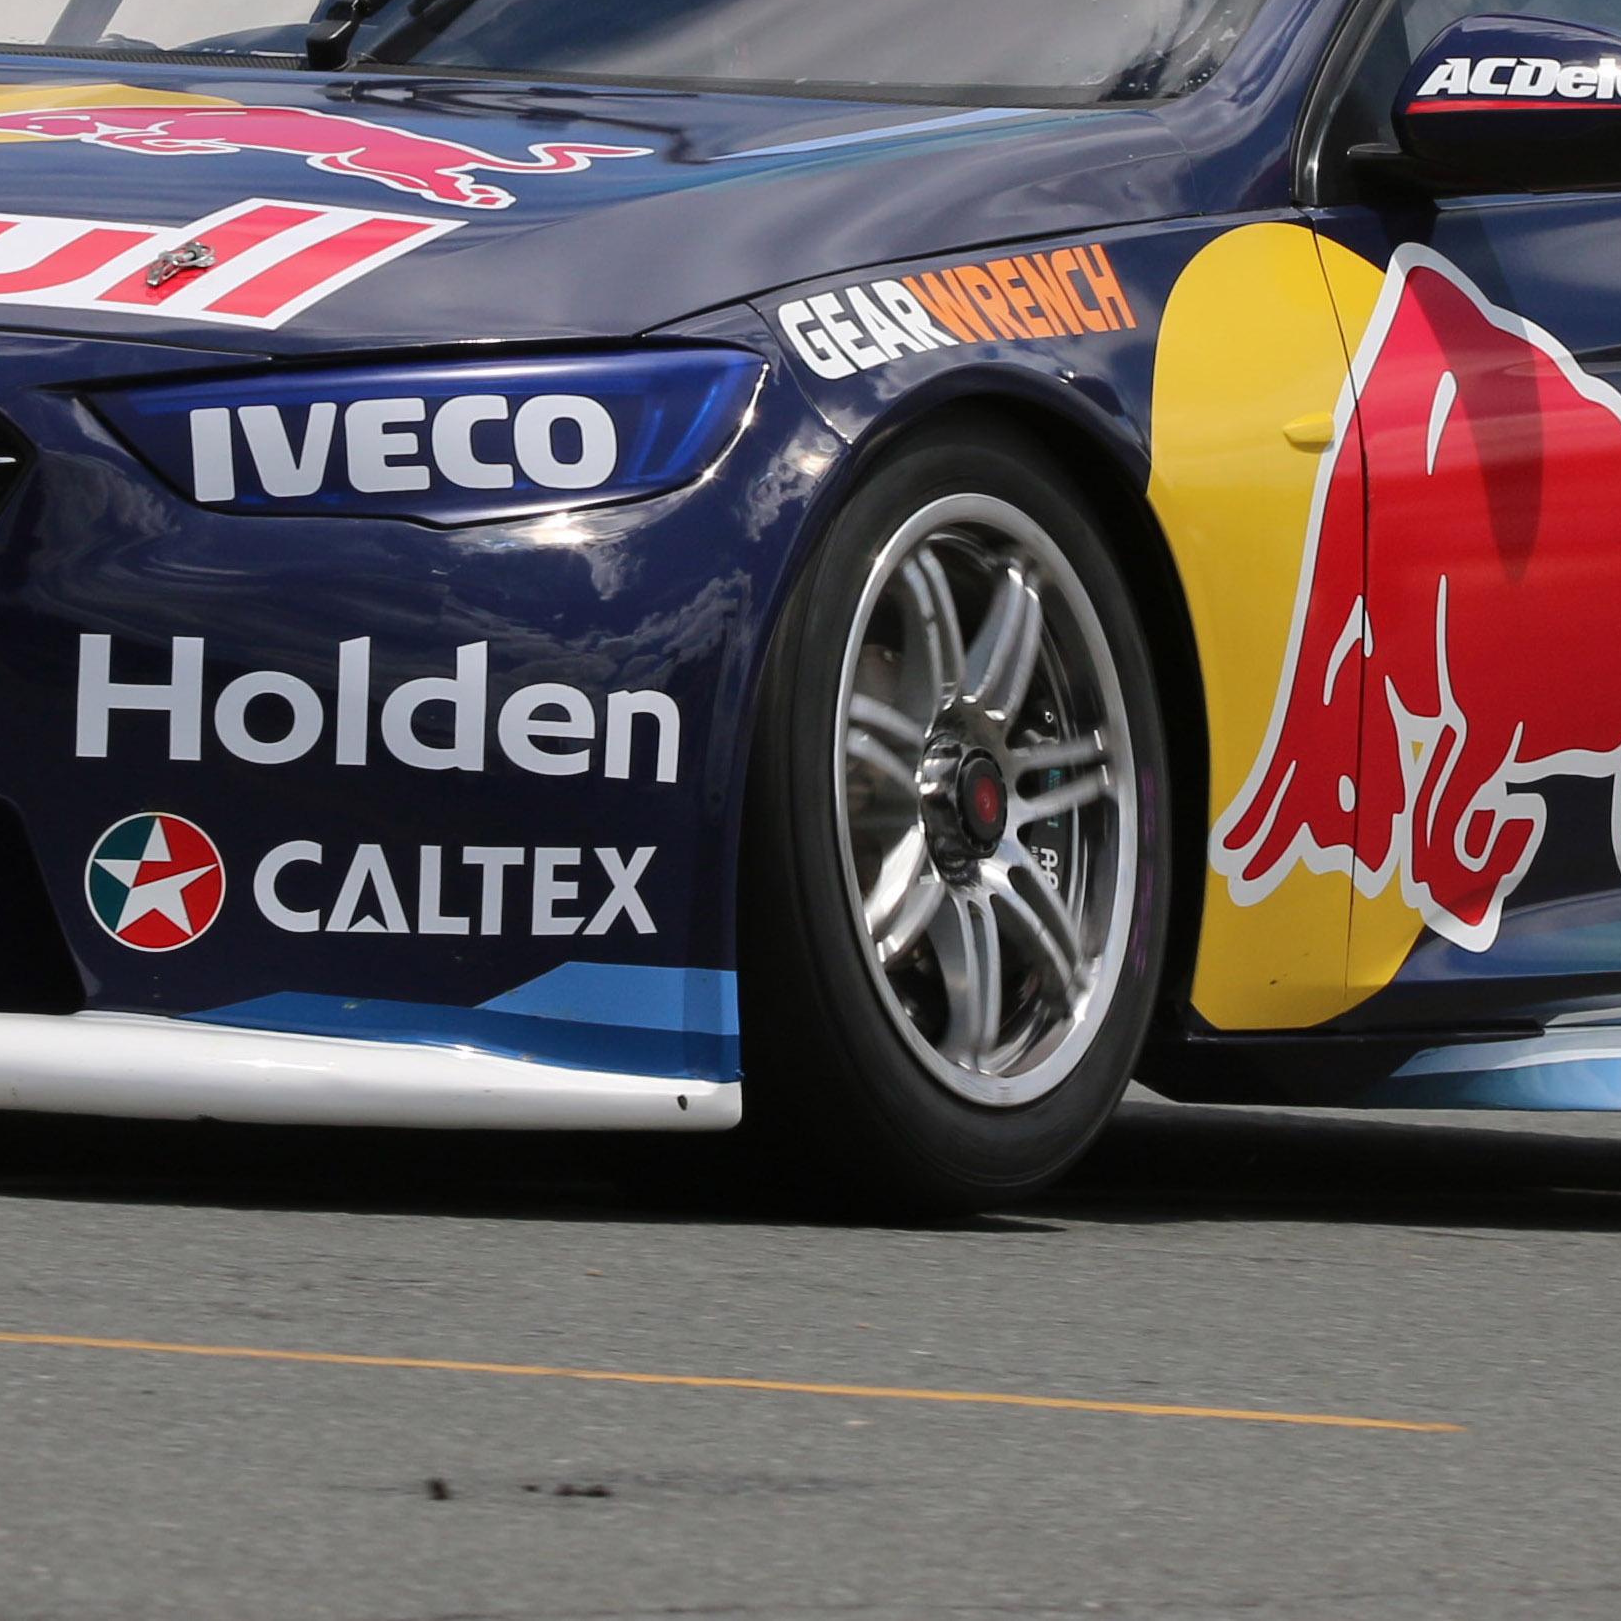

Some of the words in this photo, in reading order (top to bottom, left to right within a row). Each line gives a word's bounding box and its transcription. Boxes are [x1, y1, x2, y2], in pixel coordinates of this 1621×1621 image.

[779, 243, 1137, 379] GEARWRENCH
[190, 394, 618, 502] IVECO
[75, 633, 680, 783] Holden
[253, 840, 657, 935] CALTEX
